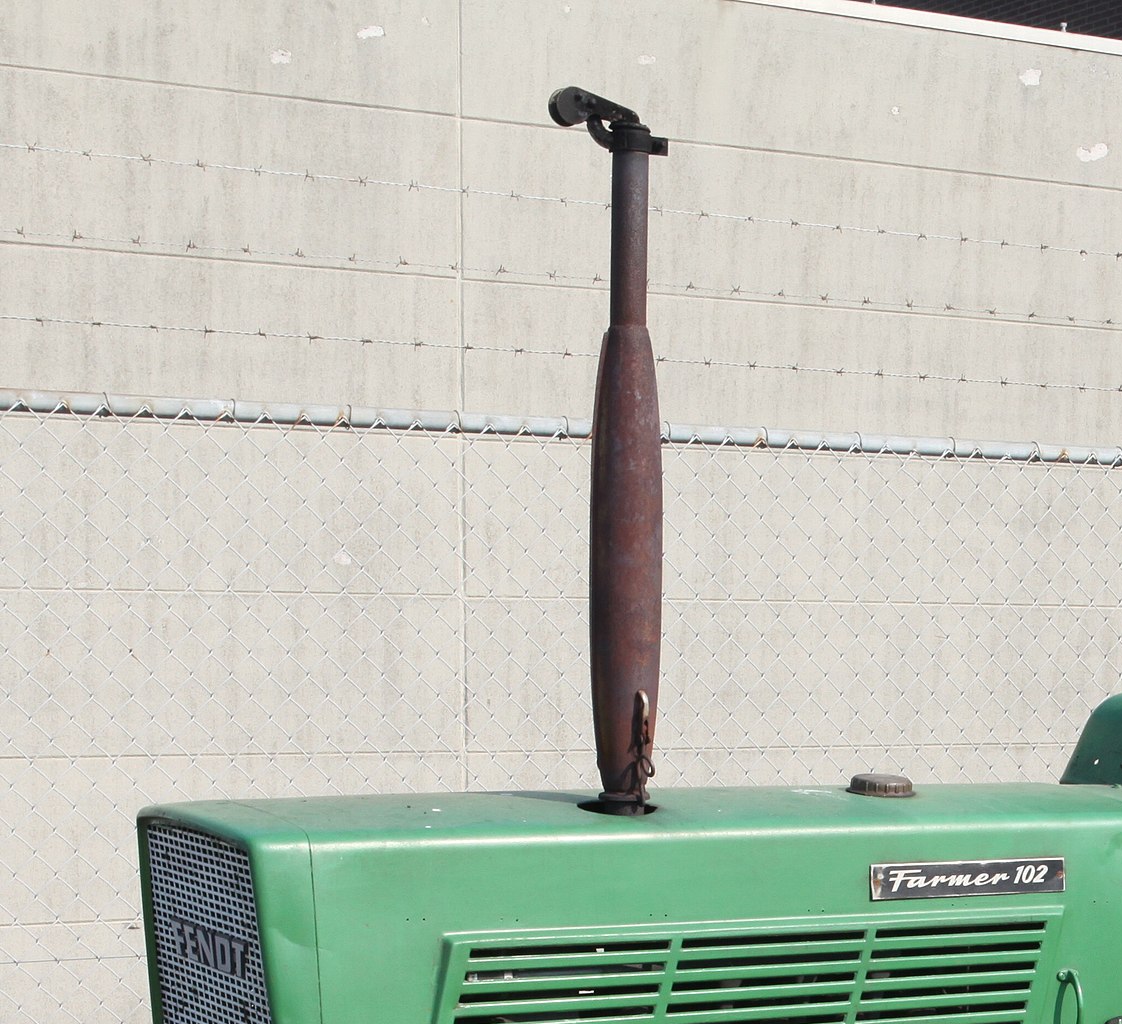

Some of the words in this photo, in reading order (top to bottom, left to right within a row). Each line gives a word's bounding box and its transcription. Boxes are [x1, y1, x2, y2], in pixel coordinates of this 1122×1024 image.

[889, 869, 1010, 893] Farmer
[1013, 864, 1049, 884] 102
[171, 919, 245, 978] FENDT
